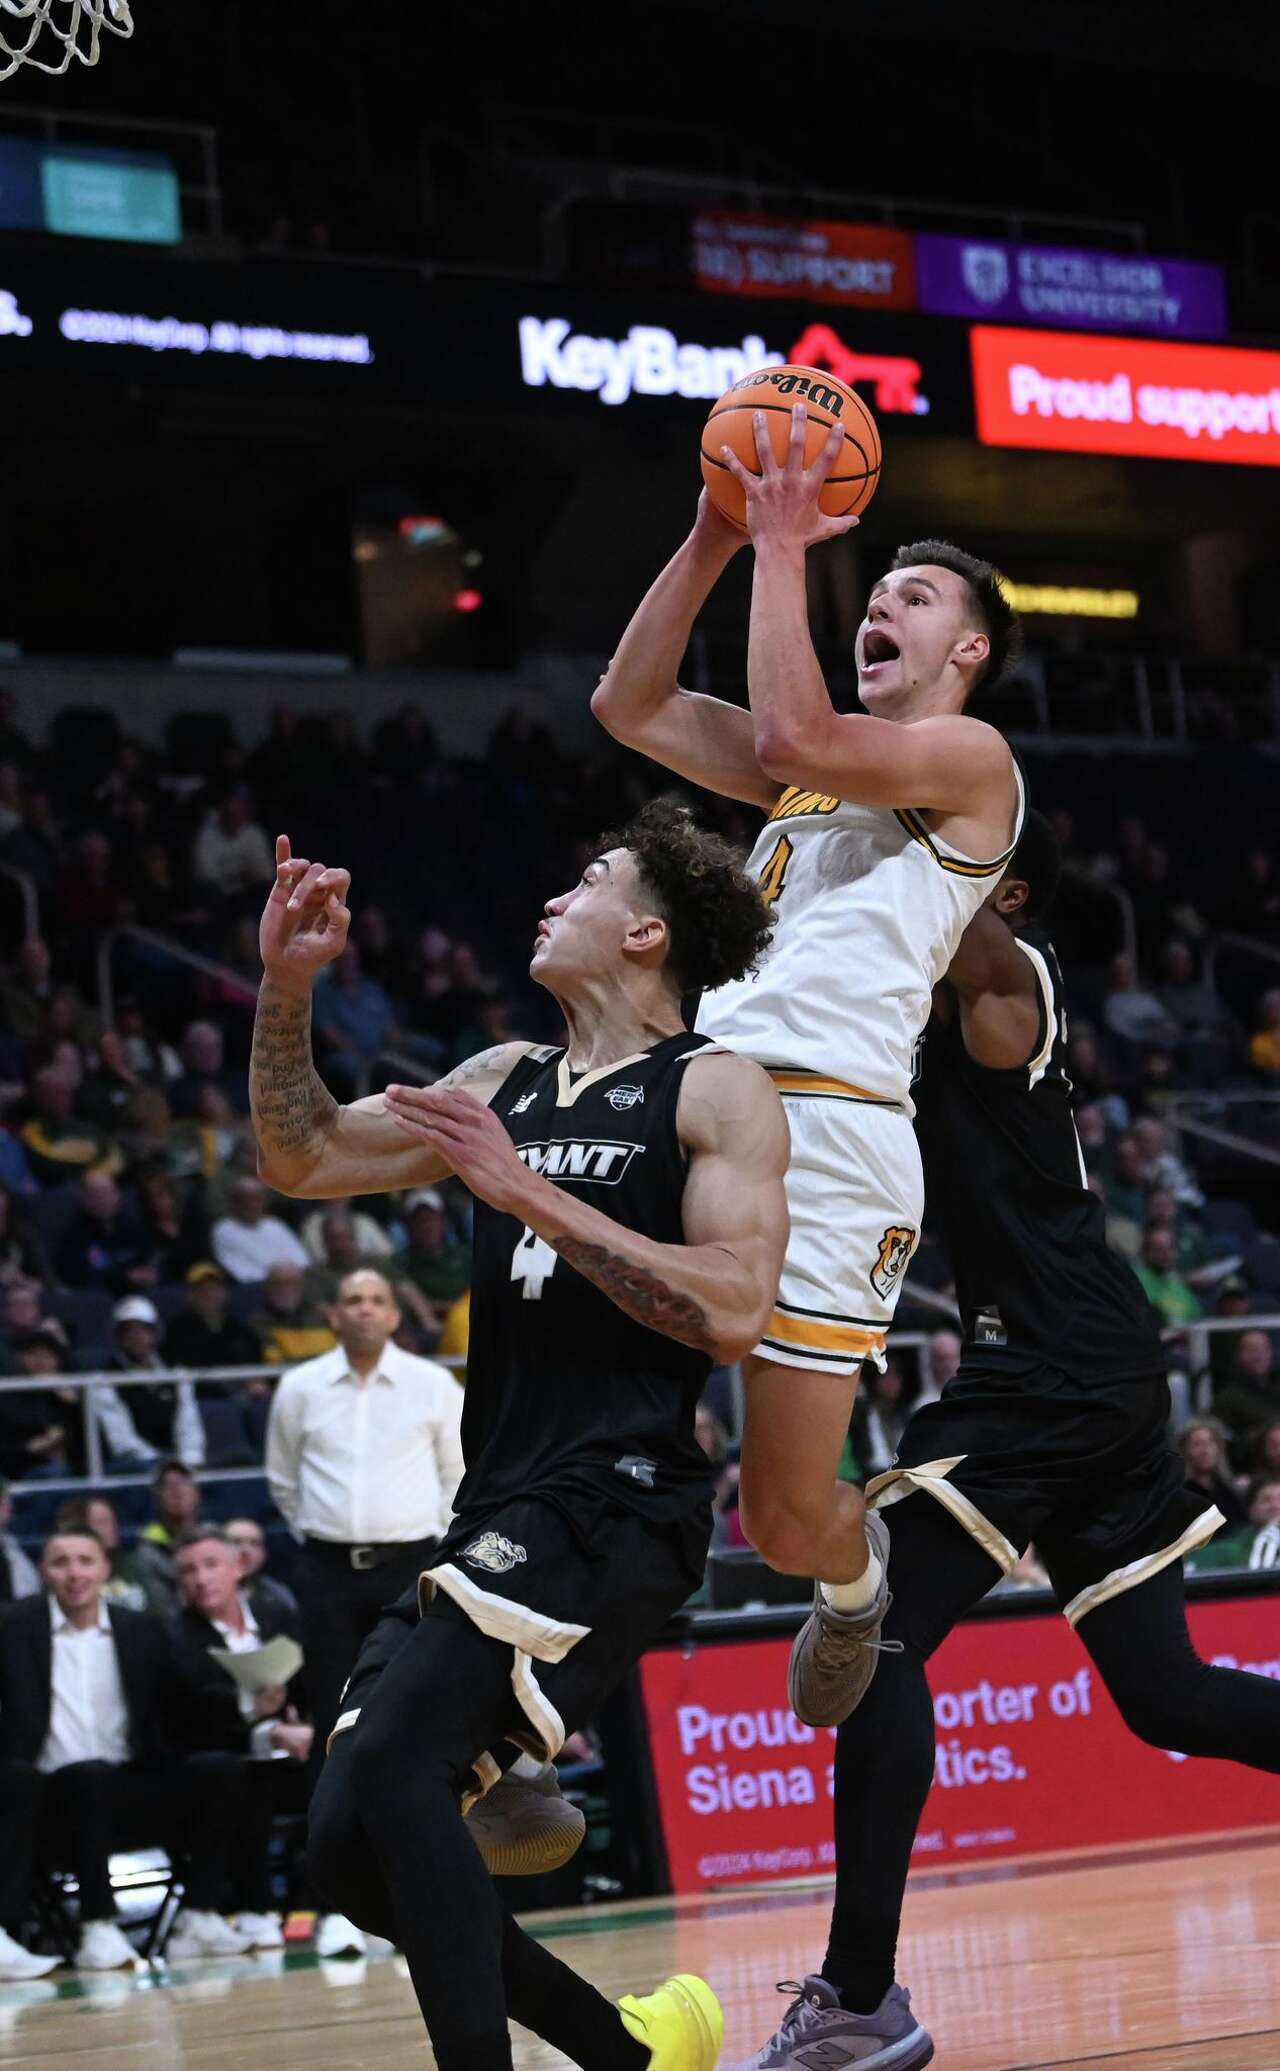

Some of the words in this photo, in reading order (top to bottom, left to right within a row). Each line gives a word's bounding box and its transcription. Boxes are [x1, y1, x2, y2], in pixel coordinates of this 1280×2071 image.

[1019, 286, 1182, 325] UNIVERSITY
[518, 315, 786, 406] KeyBank
[1008, 363, 1133, 424] Proud
[759, 834, 794, 907] 4
[517, 1144, 629, 1177] YANT
[510, 1224, 558, 1300] 4
[985, 1328, 997, 1341] M
[1049, 1668, 1092, 1718] of
[686, 1763, 816, 1816] Siena
